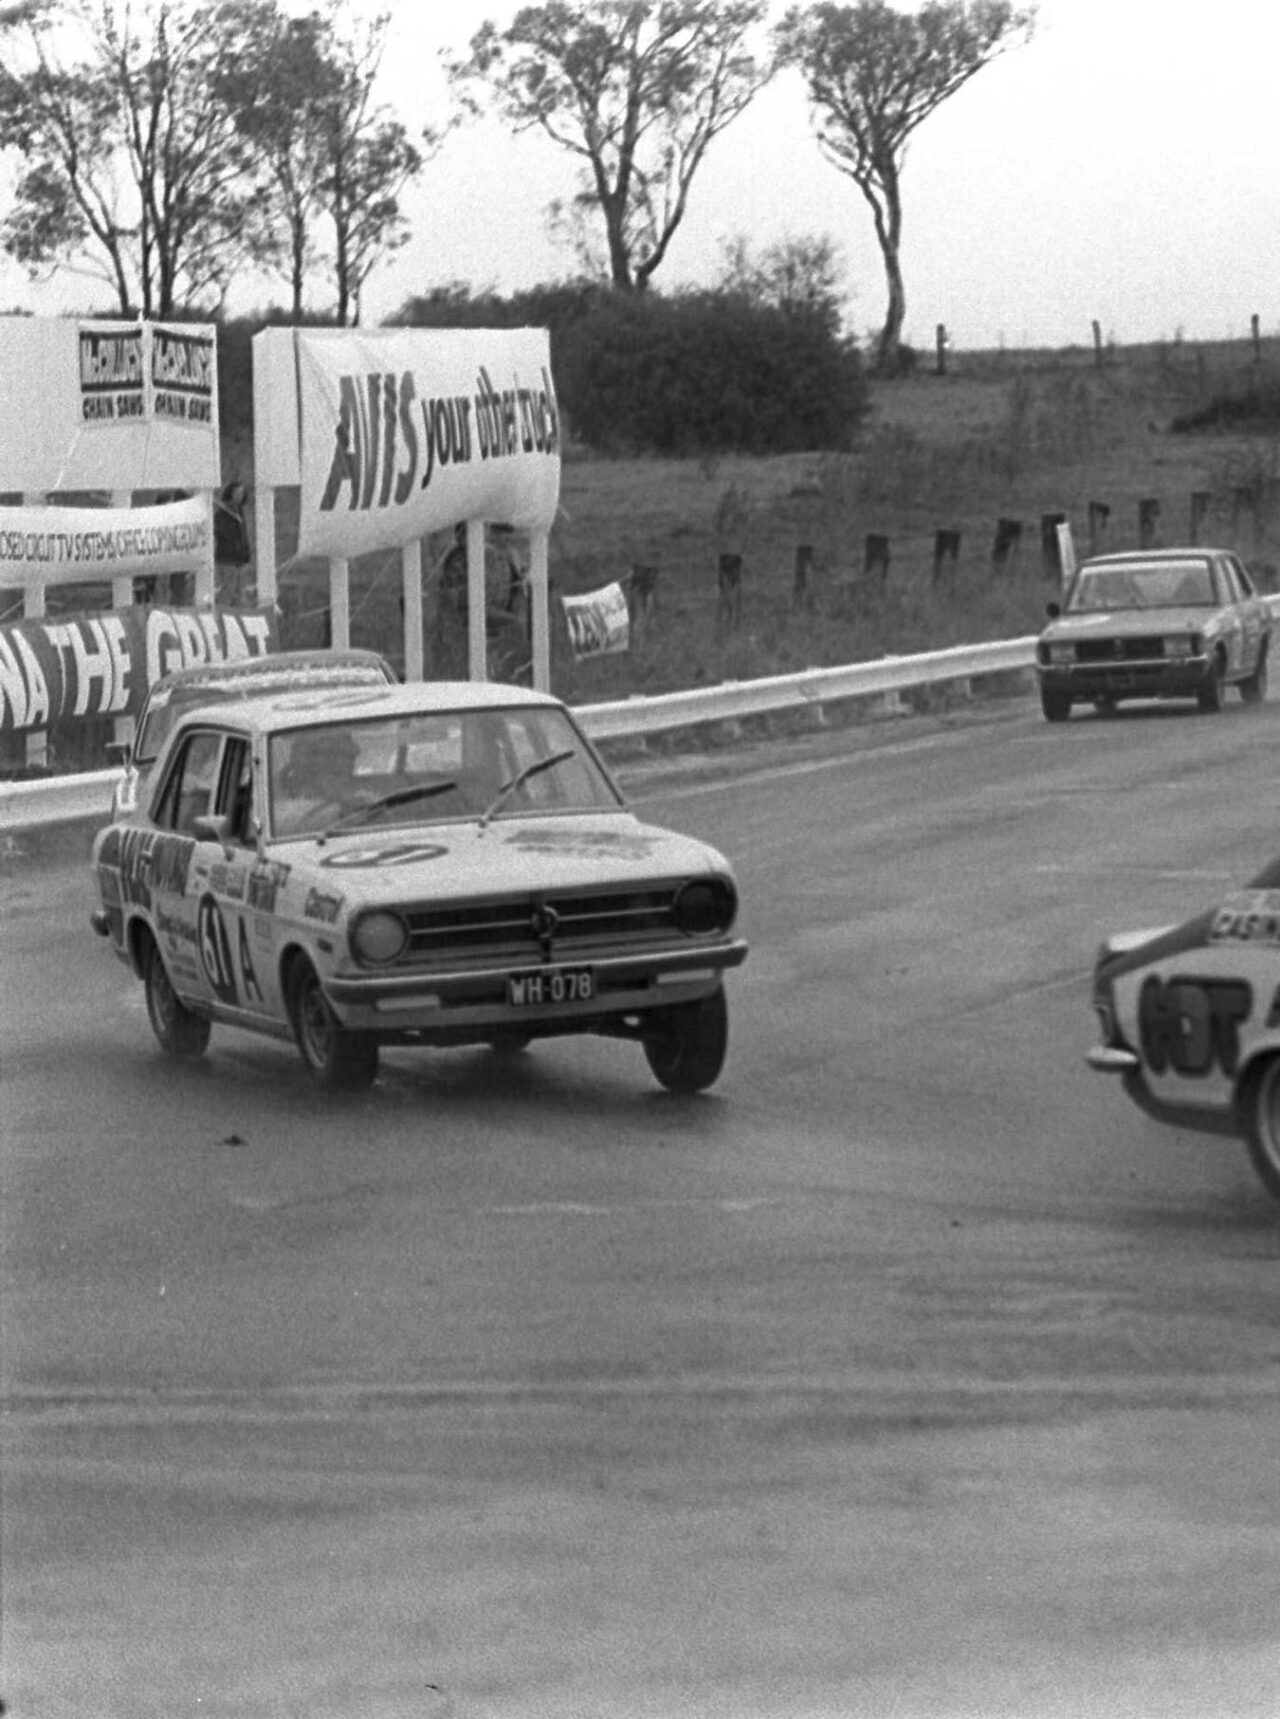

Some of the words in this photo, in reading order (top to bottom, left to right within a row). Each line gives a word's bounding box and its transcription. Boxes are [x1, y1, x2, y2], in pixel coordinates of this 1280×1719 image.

[319, 369, 418, 511] AVIS
[421, 397, 472, 489] your
[42, 615, 132, 716] THE
